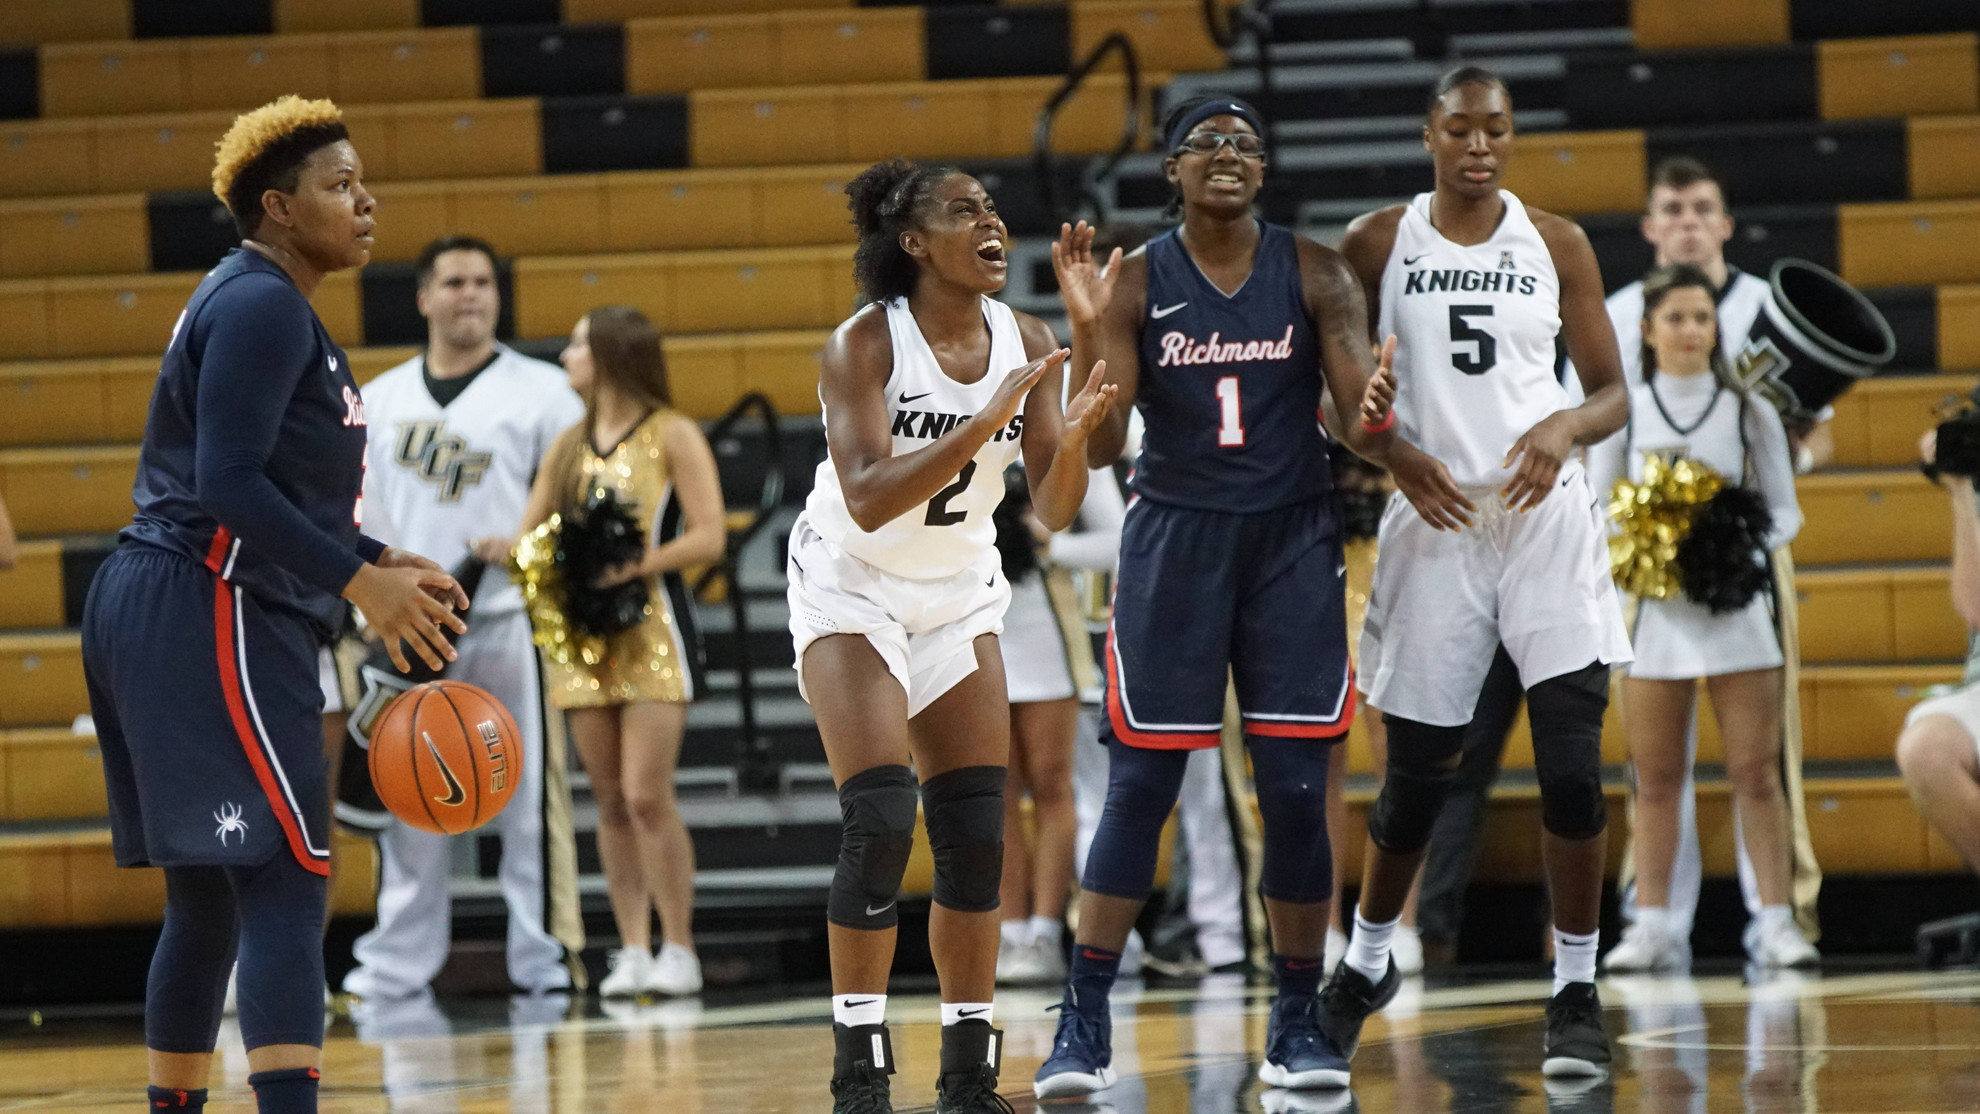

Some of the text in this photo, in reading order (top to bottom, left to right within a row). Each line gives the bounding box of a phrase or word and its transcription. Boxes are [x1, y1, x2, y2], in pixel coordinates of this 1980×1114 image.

[1404, 269, 1538, 296] KNIGHTS
[1157, 323, 1294, 368] Richmond
[1448, 304, 1497, 376] 5
[891, 409, 1024, 443] KNIS
[1215, 375, 1246, 447] 1
[394, 419, 493, 503] UCF
[924, 458, 977, 526] 2
[476, 720, 506, 794] ELITE
